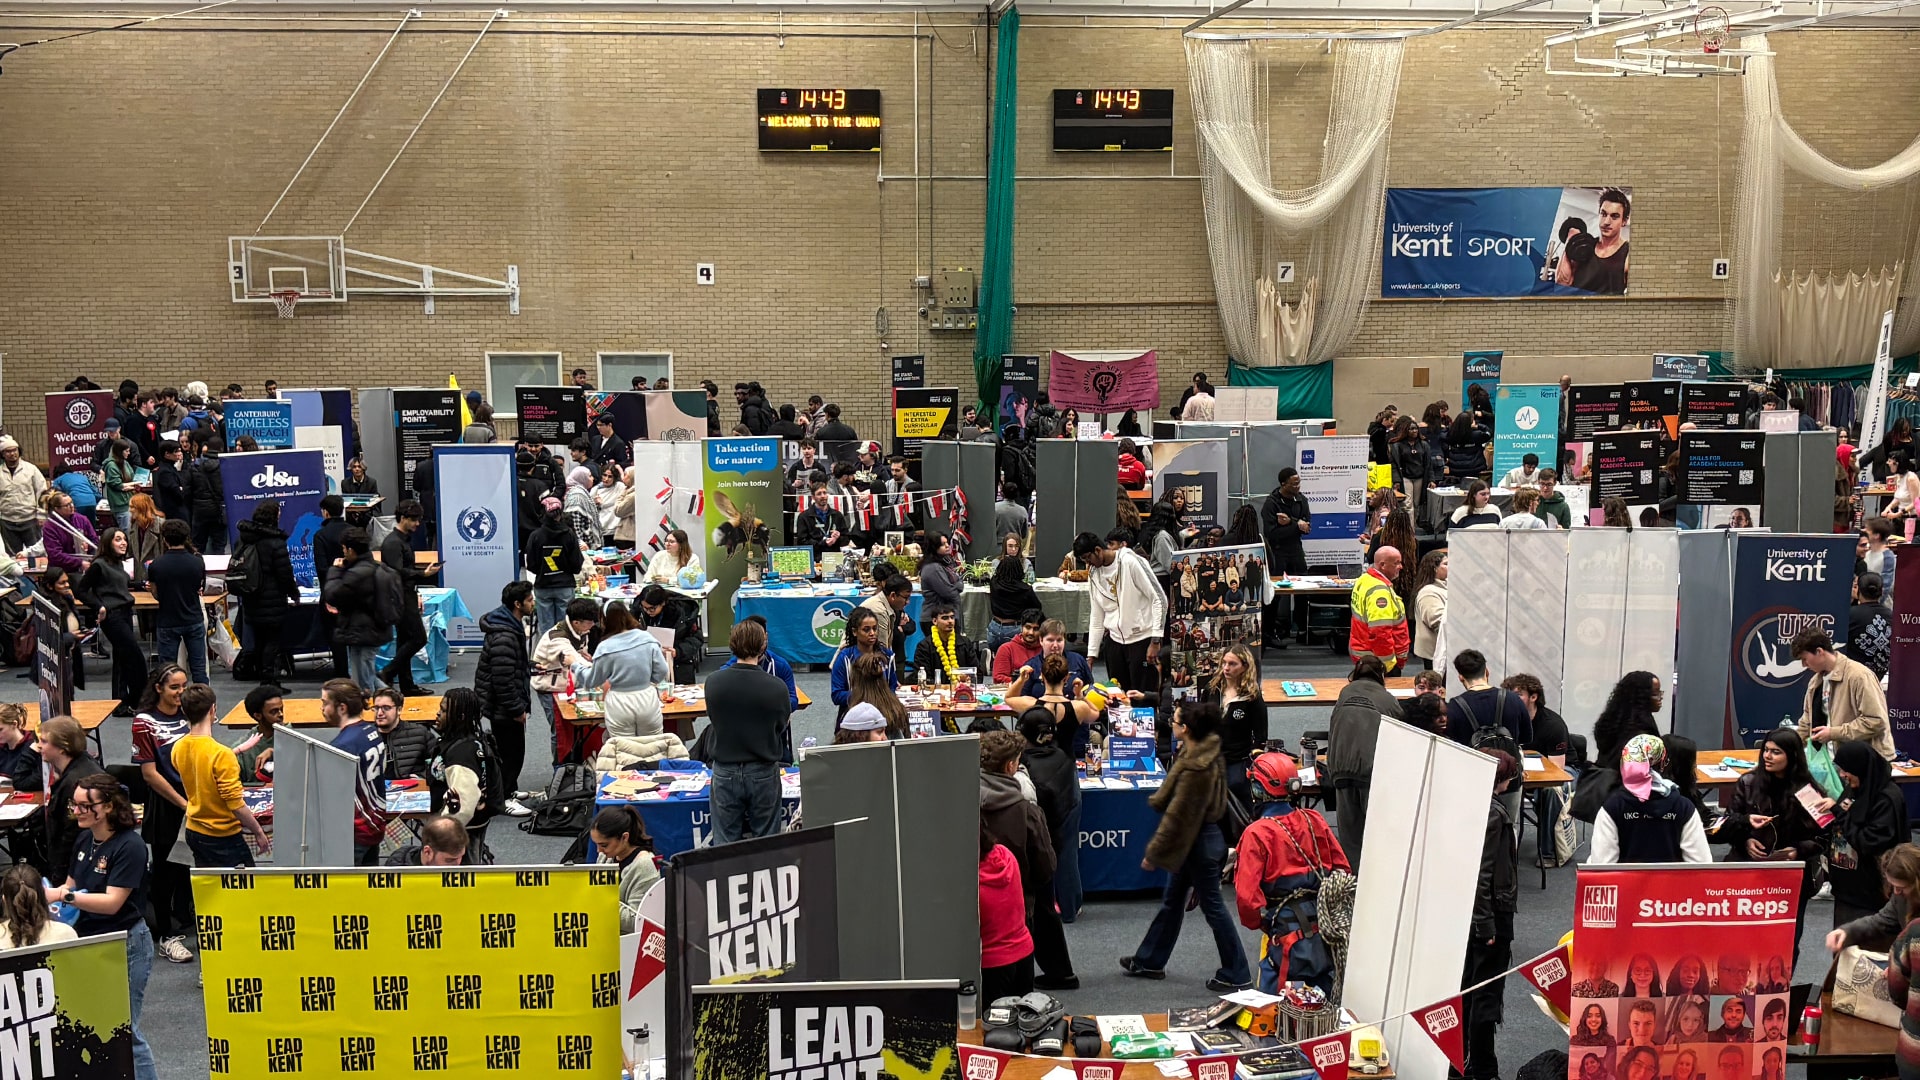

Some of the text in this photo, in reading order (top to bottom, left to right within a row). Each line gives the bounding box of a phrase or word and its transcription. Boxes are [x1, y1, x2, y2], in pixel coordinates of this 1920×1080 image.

[800, 90, 846, 110] 14:43
[1094, 90, 1140, 110] 14:43
[768, 116, 812, 128] WELCOME
[816, 116, 829, 128] TO
[833, 116, 852, 128] THE
[1392, 222, 1454, 234] University of
[1391, 234, 1453, 257] Kent
[1467, 238, 1536, 257] SPORT
[233, 266, 244, 280] 3
[700, 268, 712, 281] 4
[1280, 266, 1292, 279] 7
[1390, 282, 1461, 290] www.kent.ac.uk/sports
[1466, 364, 1500, 372] streetwise
[228, 418, 290, 428] HOMELESS
[234, 410, 280, 418] CANTERBURY
[402, 416, 428, 424] POINTS
[54, 432, 109, 442] Welcome to
[228, 428, 289, 438] OUTREACH
[56, 444, 70, 455] the
[715, 443, 770, 453] Take action
[715, 456, 729, 465] for
[251, 464, 300, 488] elsa
[750, 480, 770, 488] today
[1767, 549, 1828, 560] University of
[1765, 559, 1826, 581] Kent
[1778, 614, 1834, 639] UKC
[1889, 709, 1910, 719] Sign
[1897, 721, 1915, 730] both
[1624, 812, 1639, 820] UKC
[1078, 830, 1130, 848] PORT
[221, 872, 254, 888] KENT
[294, 872, 328, 888] KENT
[368, 872, 402, 888] KENT
[442, 872, 476, 888] KENT
[516, 872, 550, 888] KENT
[706, 864, 799, 936] LEAD
[1585, 887, 1616, 904] KENT
[1705, 888, 1724, 896] Your
[1584, 906, 1616, 921] UNION
[1639, 898, 1789, 918] Student Reps
[260, 916, 295, 936] LEAD
[333, 915, 368, 934] LEAD
[407, 914, 442, 934] LEAD
[480, 914, 516, 933] LEAD
[554, 913, 588, 932] LEAD
[261, 932, 296, 950] KENT
[334, 930, 369, 950] KENT
[408, 930, 442, 949] KENT
[482, 929, 516, 948] KENT
[555, 928, 589, 947] KENT
[708, 906, 799, 980] KENT
[1534, 958, 1561, 978] STUDENT
[1547, 969, 1564, 982] REPS!
[227, 978, 262, 997] LEAD
[301, 977, 336, 996] LEAD
[373, 976, 408, 995] LEAD
[446, 975, 482, 994] LEAD
[519, 974, 554, 993] LEAD
[228, 993, 262, 1012] KENT
[302, 992, 336, 1011] KENT
[374, 991, 408, 1010] KENT
[448, 990, 482, 1010] KENT
[520, 990, 554, 1009] KENT
[1426, 1007, 1454, 1023] STUDENT
[1439, 1018, 1455, 1029] REPS!
[268, 1038, 302, 1057] LEAD
[340, 1037, 375, 1056] LEAD
[412, 1036, 448, 1055] LEAD
[486, 1036, 520, 1054] LEAD
[558, 1036, 592, 1054] LEAD
[768, 1006, 884, 1072] LEAD
[1315, 1043, 1341, 1057] STUDENT
[1326, 1054, 1343, 1064] REPS!
[268, 1054, 303, 1072] KENT
[341, 1052, 376, 1072] KENT
[414, 1051, 448, 1070] KENT
[487, 1050, 520, 1070] KENT
[558, 1050, 592, 1070] KENT
[970, 1057, 996, 1069] STUDENT
[977, 1069, 994, 1080] REPS!
[1085, 1069, 1111, 1078] STUDENT
[1200, 1064, 1226, 1075] STUDENT
